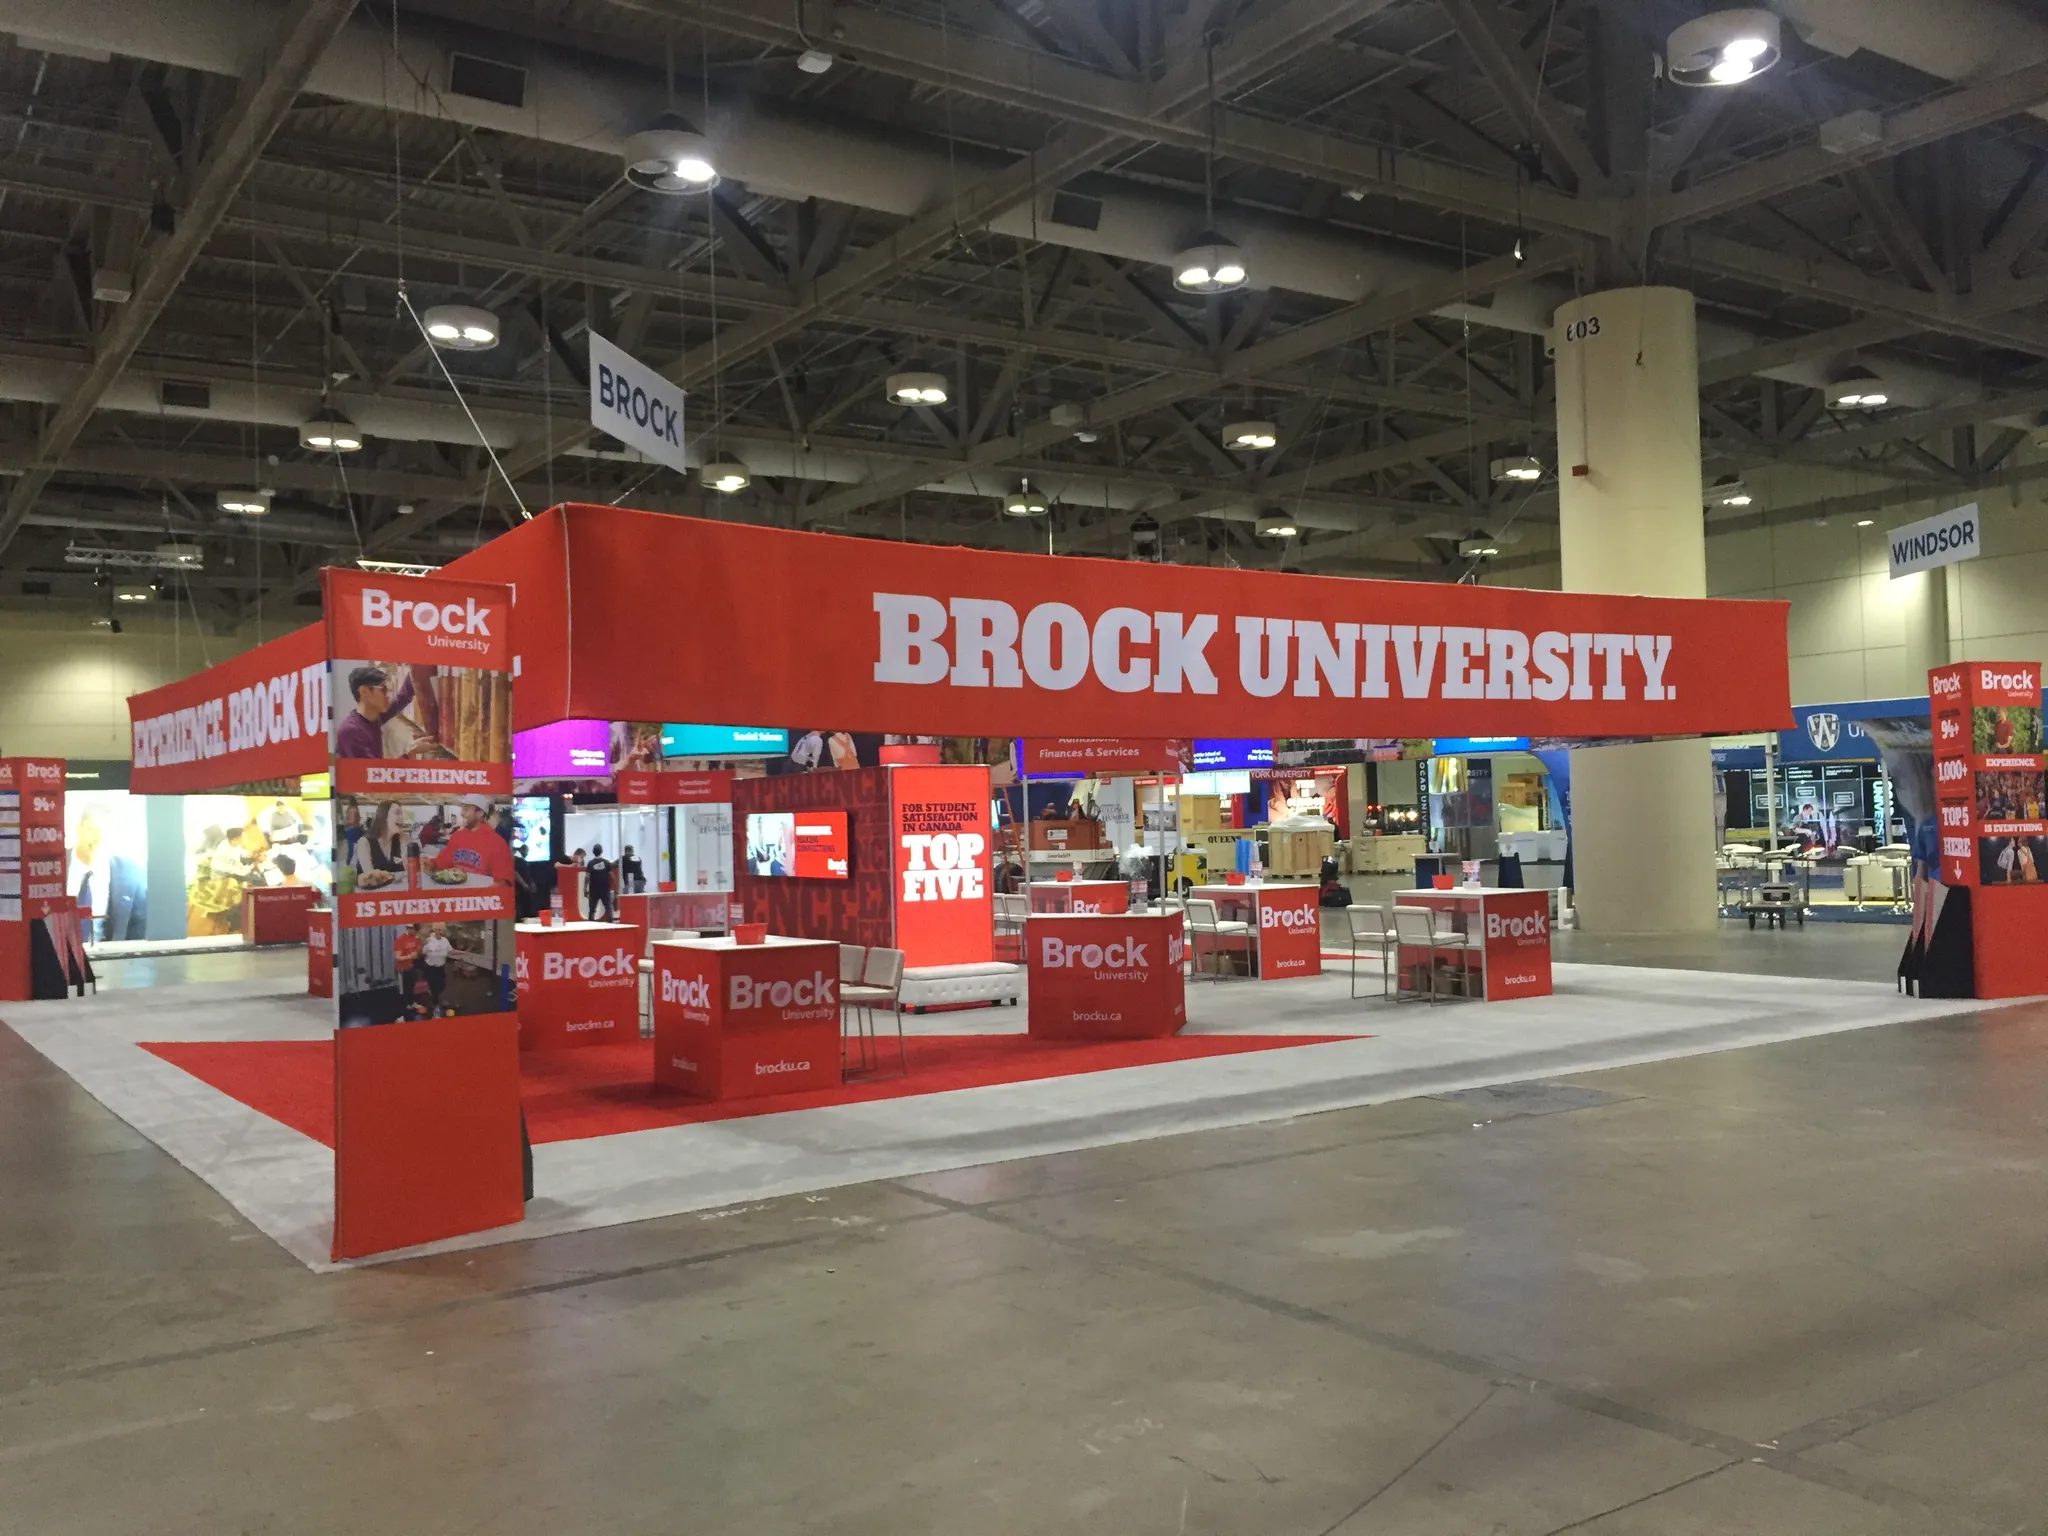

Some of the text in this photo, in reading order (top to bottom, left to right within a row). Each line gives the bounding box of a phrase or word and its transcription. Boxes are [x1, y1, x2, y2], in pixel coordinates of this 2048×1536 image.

[1567, 317, 1600, 341] 603
[599, 363, 678, 447] BROCK
[1892, 520, 1974, 564] WINDSOR
[362, 588, 490, 636] Brock
[428, 635, 490, 654] University
[873, 592, 1676, 702] BROCK UNIVERSITY.
[1933, 673, 1960, 694] Brock
[1980, 670, 2033, 690] Brock
[134, 698, 227, 768] EXPERIENCE.
[228, 671, 299, 752] BROCK
[1040, 748, 1139, 758] Finances & Services
[26, 763, 61, 778] Brock
[367, 768, 490, 786] EXPERIENCE.
[1250, 770, 1270, 779] YORK
[1272, 770, 1311, 778] UNIVERSITY
[1938, 760, 1968, 784] 1,000+
[902, 802, 976, 812] FOR STUDENT
[1942, 807, 1962, 826] TOP
[903, 812, 978, 822] SATISFACTION
[903, 822, 962, 832] IN CANADA
[902, 833, 984, 870] TOP
[903, 868, 984, 902] FIVE
[356, 896, 504, 917] IS EVERYTHING.
[1261, 904, 1315, 928] Brock
[1288, 926, 1316, 935] University
[1488, 910, 1546, 938] Brock
[1042, 936, 1149, 968] Brock
[544, 948, 635, 980] Brock
[1277, 959, 1305, 968] brocku.ca
[588, 978, 634, 988] University
[1094, 970, 1148, 982] University
[1505, 975, 1536, 985] brocku.ca
[662, 969, 711, 1009] Brock
[730, 970, 835, 1010] Brock
[782, 1008, 835, 1020] University
[1073, 1011, 1122, 1021] brocku.ca
[567, 1020, 614, 1031] brocku.ca
[756, 1060, 810, 1075] brocku.ca
